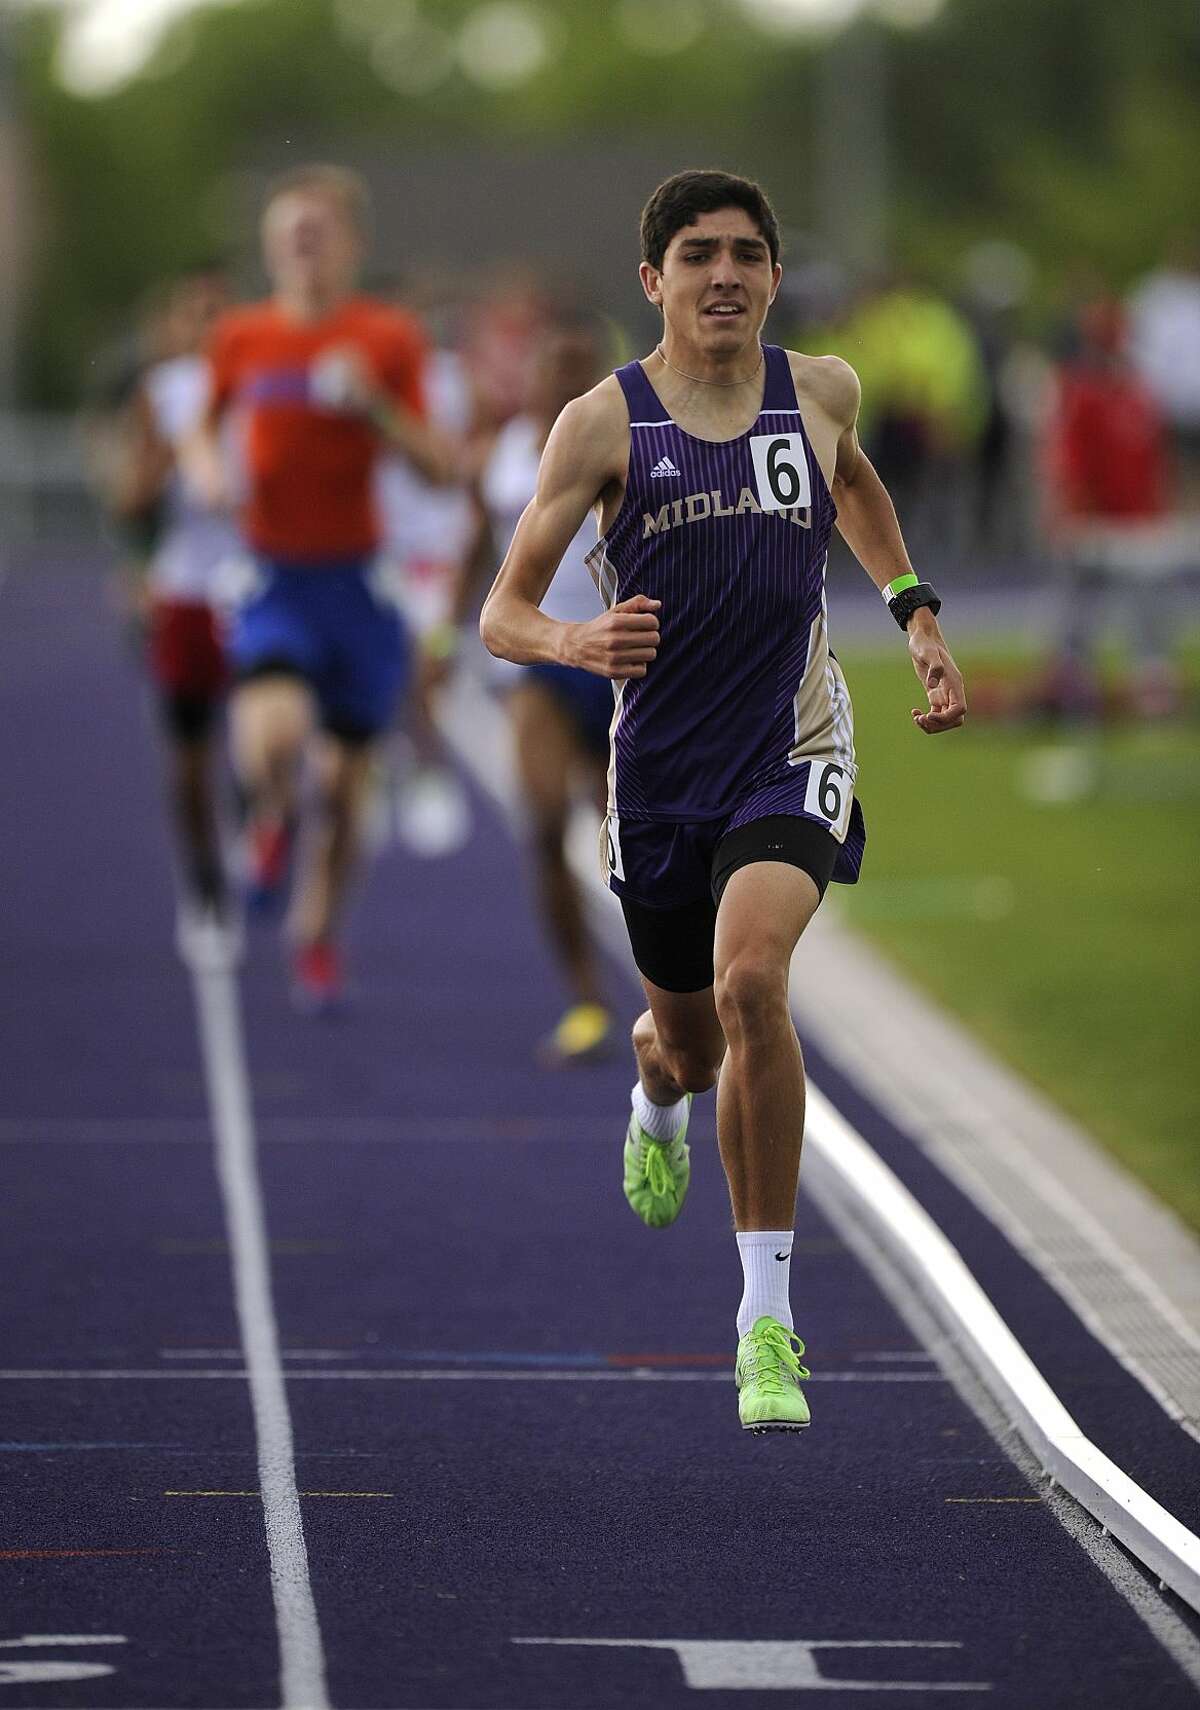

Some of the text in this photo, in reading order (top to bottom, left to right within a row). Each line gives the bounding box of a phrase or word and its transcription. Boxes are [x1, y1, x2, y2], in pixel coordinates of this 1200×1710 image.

[650, 469, 681, 478] adidas
[766, 438, 801, 505] 6
[642, 487, 812, 539] MIDLAD
[818, 762, 845, 821] 6
